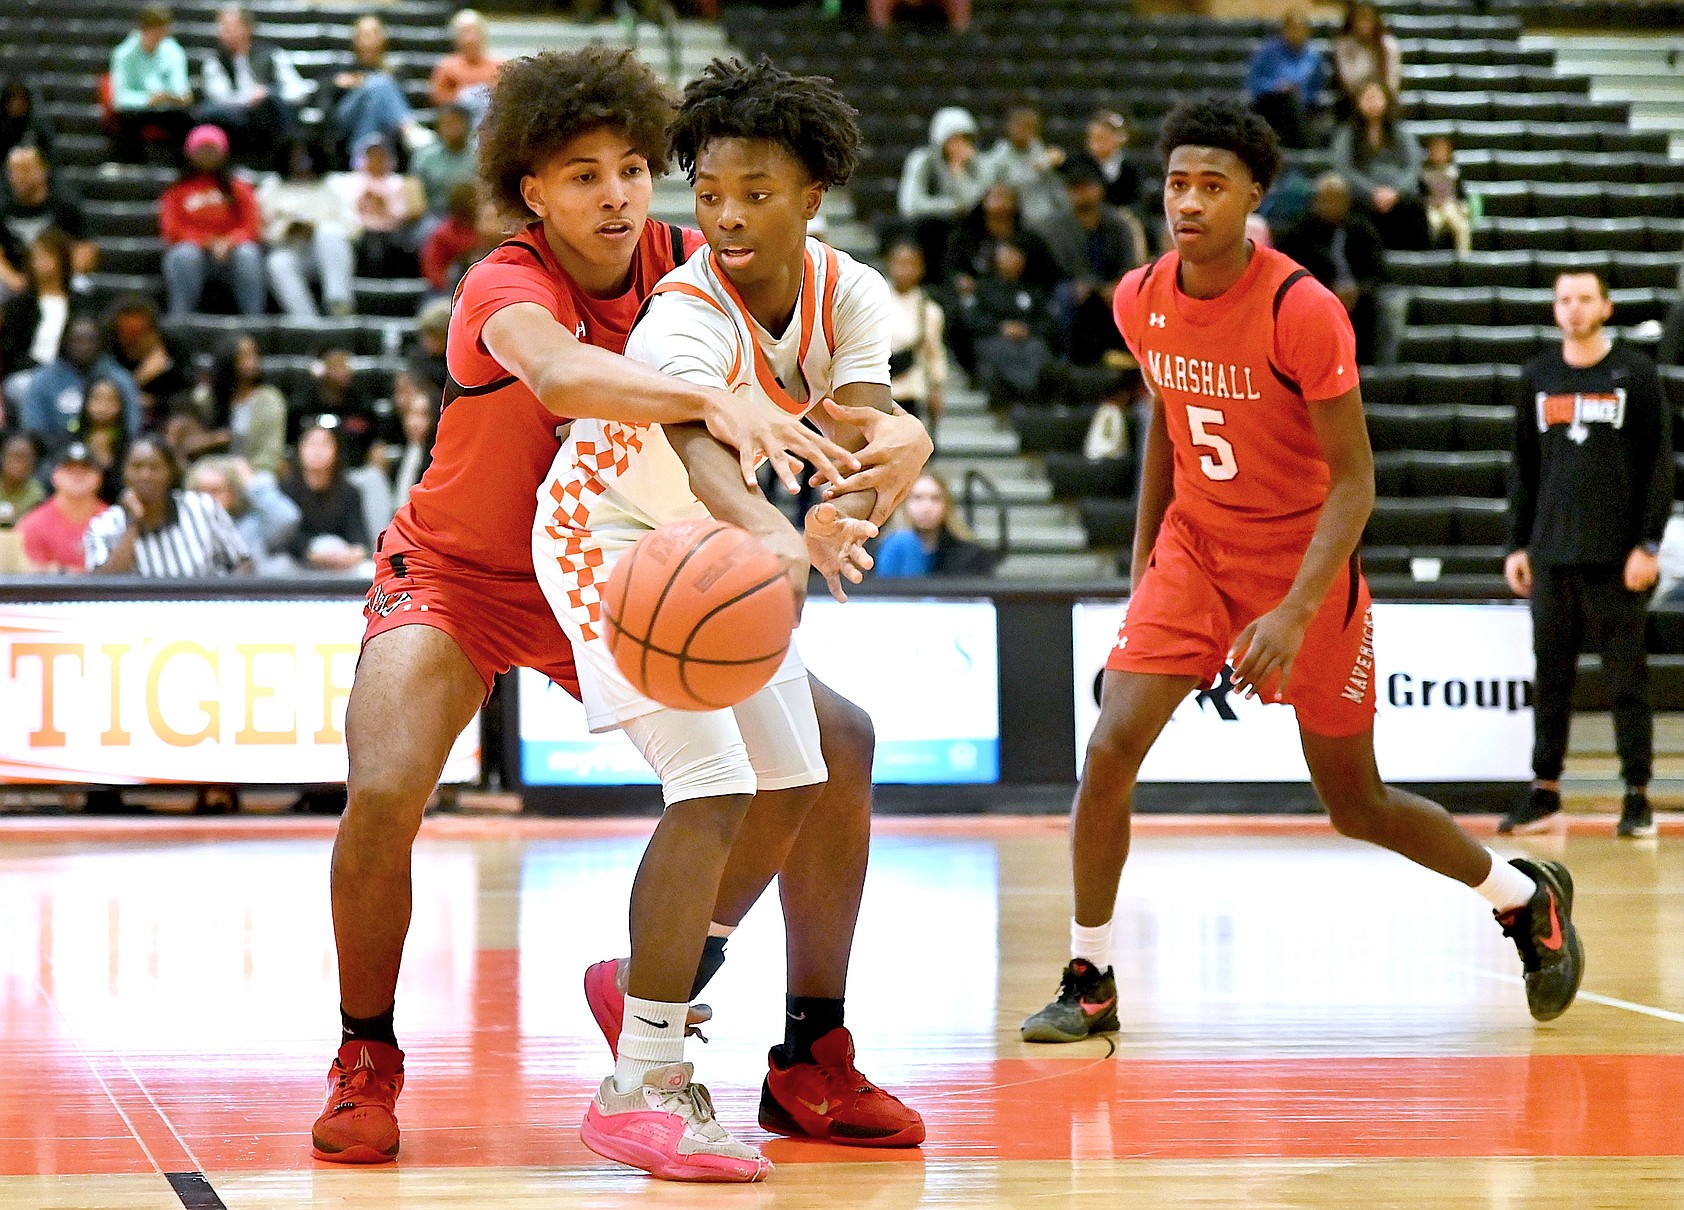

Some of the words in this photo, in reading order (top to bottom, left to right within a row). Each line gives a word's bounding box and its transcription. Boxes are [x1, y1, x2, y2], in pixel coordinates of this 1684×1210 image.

[1147, 350, 1261, 400] MARSHALL
[1186, 404, 1239, 481] 5
[1388, 672, 1535, 712] Group
